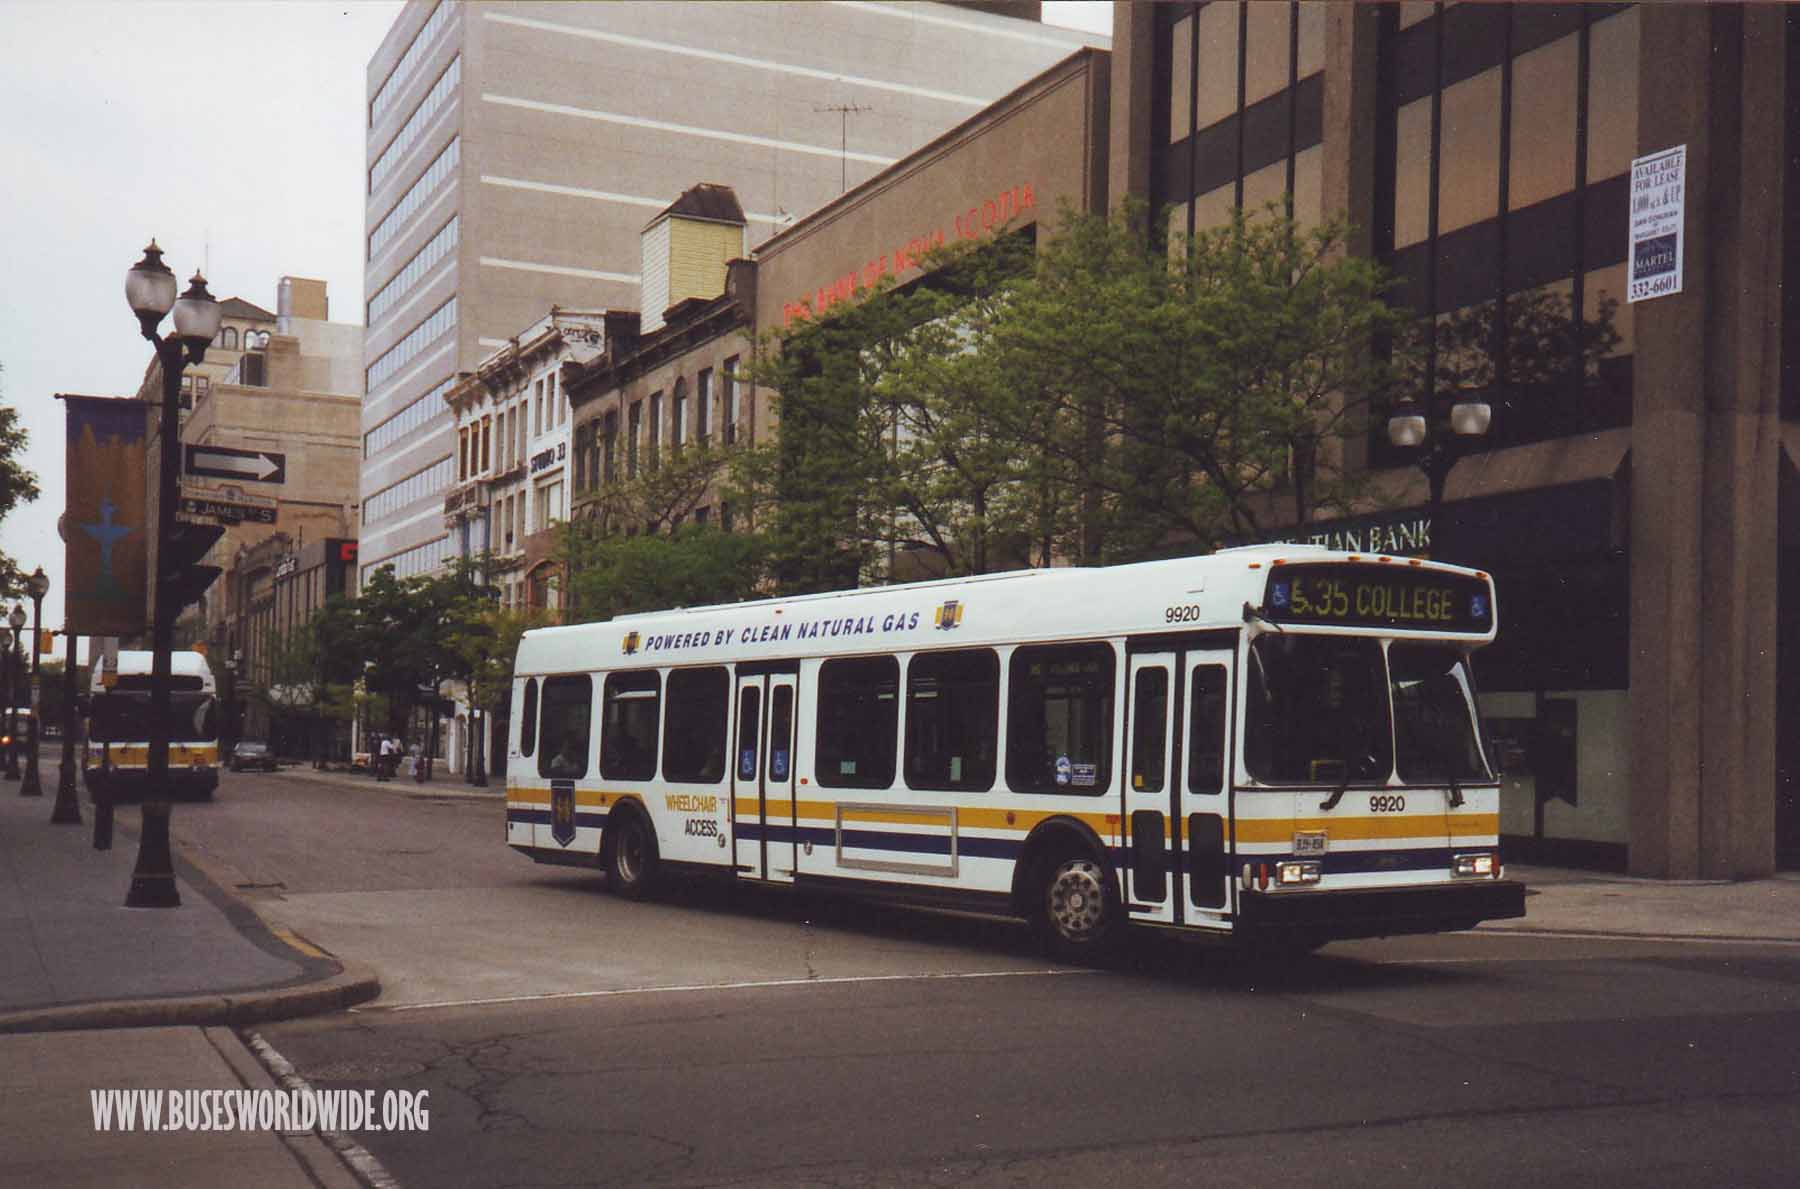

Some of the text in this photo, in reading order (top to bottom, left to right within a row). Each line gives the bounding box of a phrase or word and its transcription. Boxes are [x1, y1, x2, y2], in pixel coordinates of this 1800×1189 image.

[1634, 155, 1682, 179] AVAILABLE
[1634, 168, 1680, 192] FOR LEASE
[955, 181, 1035, 241] SCOTIA
[1369, 519, 1432, 553] BANK
[1315, 579, 1453, 620] 35 COLLEGE
[1165, 605, 1200, 623] 9920
[645, 612, 920, 650] POWERED BY CLEAN NATURAL GAS
[665, 793, 717, 813] WHEELCHAIR
[1369, 796, 1405, 812] 9920
[684, 818, 718, 838] ACCESS
